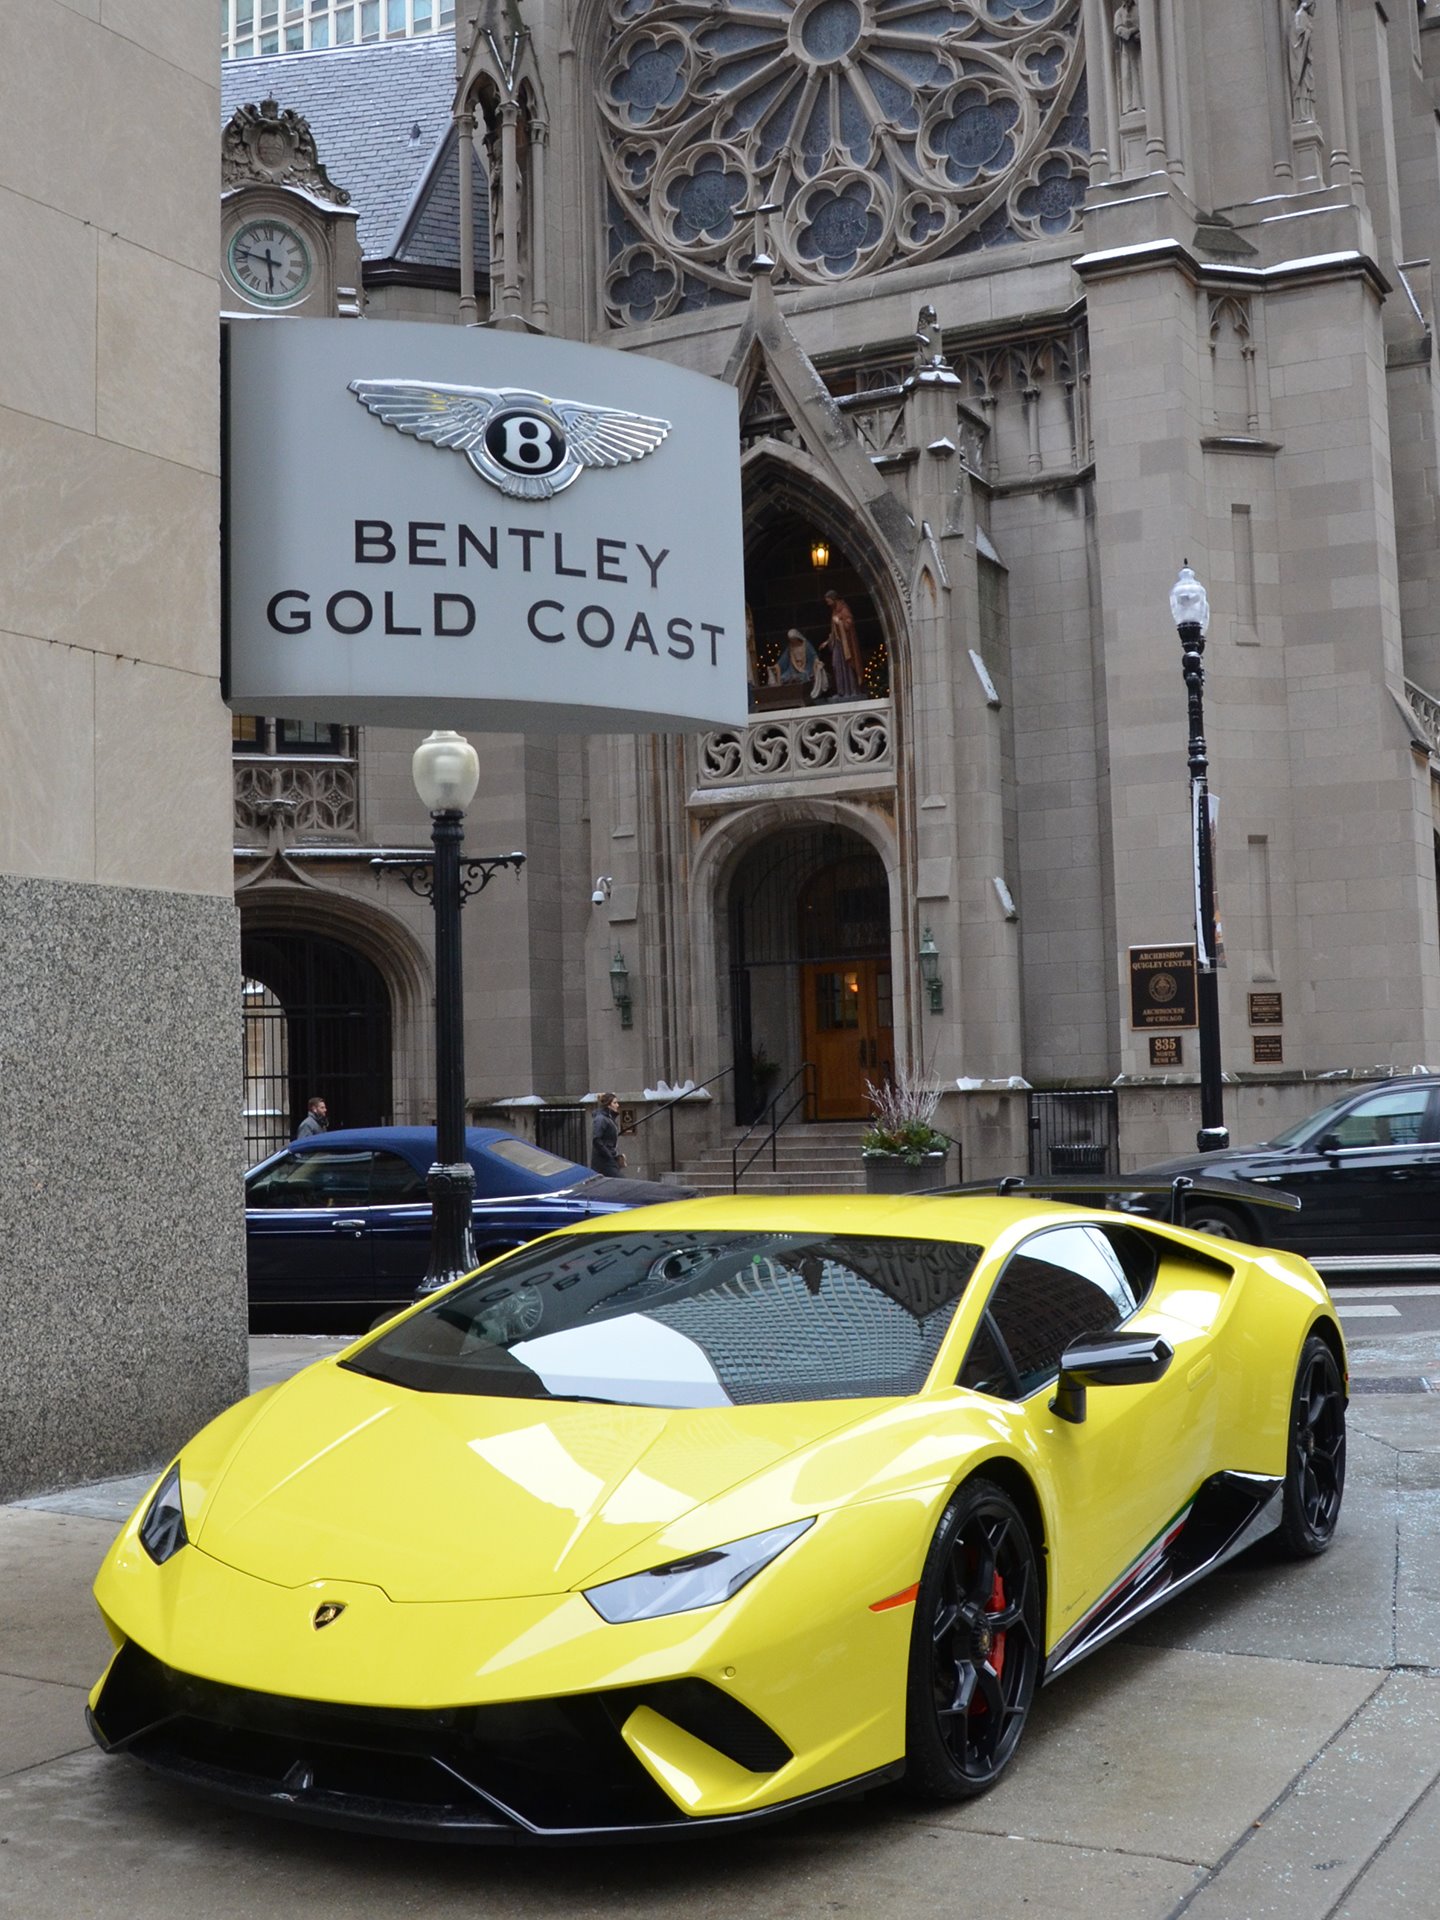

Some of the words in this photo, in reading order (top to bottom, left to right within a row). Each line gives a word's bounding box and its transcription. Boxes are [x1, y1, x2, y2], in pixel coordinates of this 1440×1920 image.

[502, 417, 553, 469] B
[354, 519, 670, 588] BENTLEY
[266, 589, 476, 637] GOLD
[527, 599, 725, 666] COAST
[1139, 951, 1185, 961] ARCHBISHOP
[1132, 961, 1163, 970] QUIGLEY
[1163, 959, 1193, 968] CENTER
[1154, 1015, 1183, 1023] CHICAGO
[1154, 1038, 1176, 1051] 835
